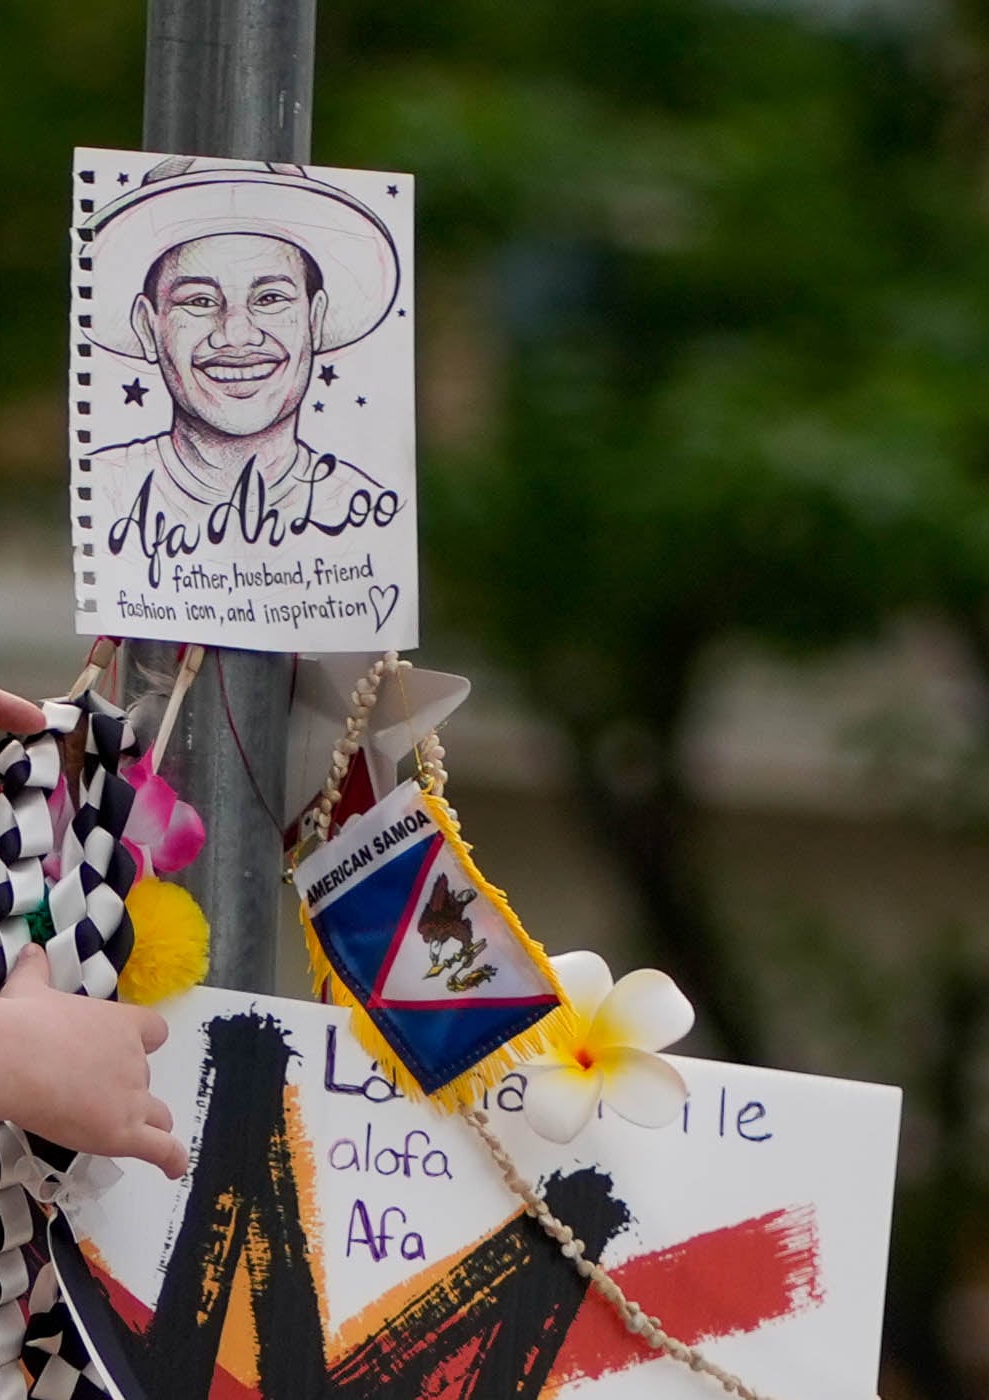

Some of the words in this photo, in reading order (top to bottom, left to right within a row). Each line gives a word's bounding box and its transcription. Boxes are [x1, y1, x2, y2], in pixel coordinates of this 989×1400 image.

[108, 469, 200, 589] Afa
[207, 454, 287, 547] Ah
[290, 453, 404, 536] Loo
[314, 553, 374, 587] friend
[117, 589, 177, 621] fashion
[227, 599, 256, 623] and
[264, 595, 368, 629] inspiration
[305, 845, 374, 909] AMERICAN
[374, 808, 432, 855] SAMOA
[329, 1122, 453, 1180] alofa
[346, 1198, 426, 1263] Afa
